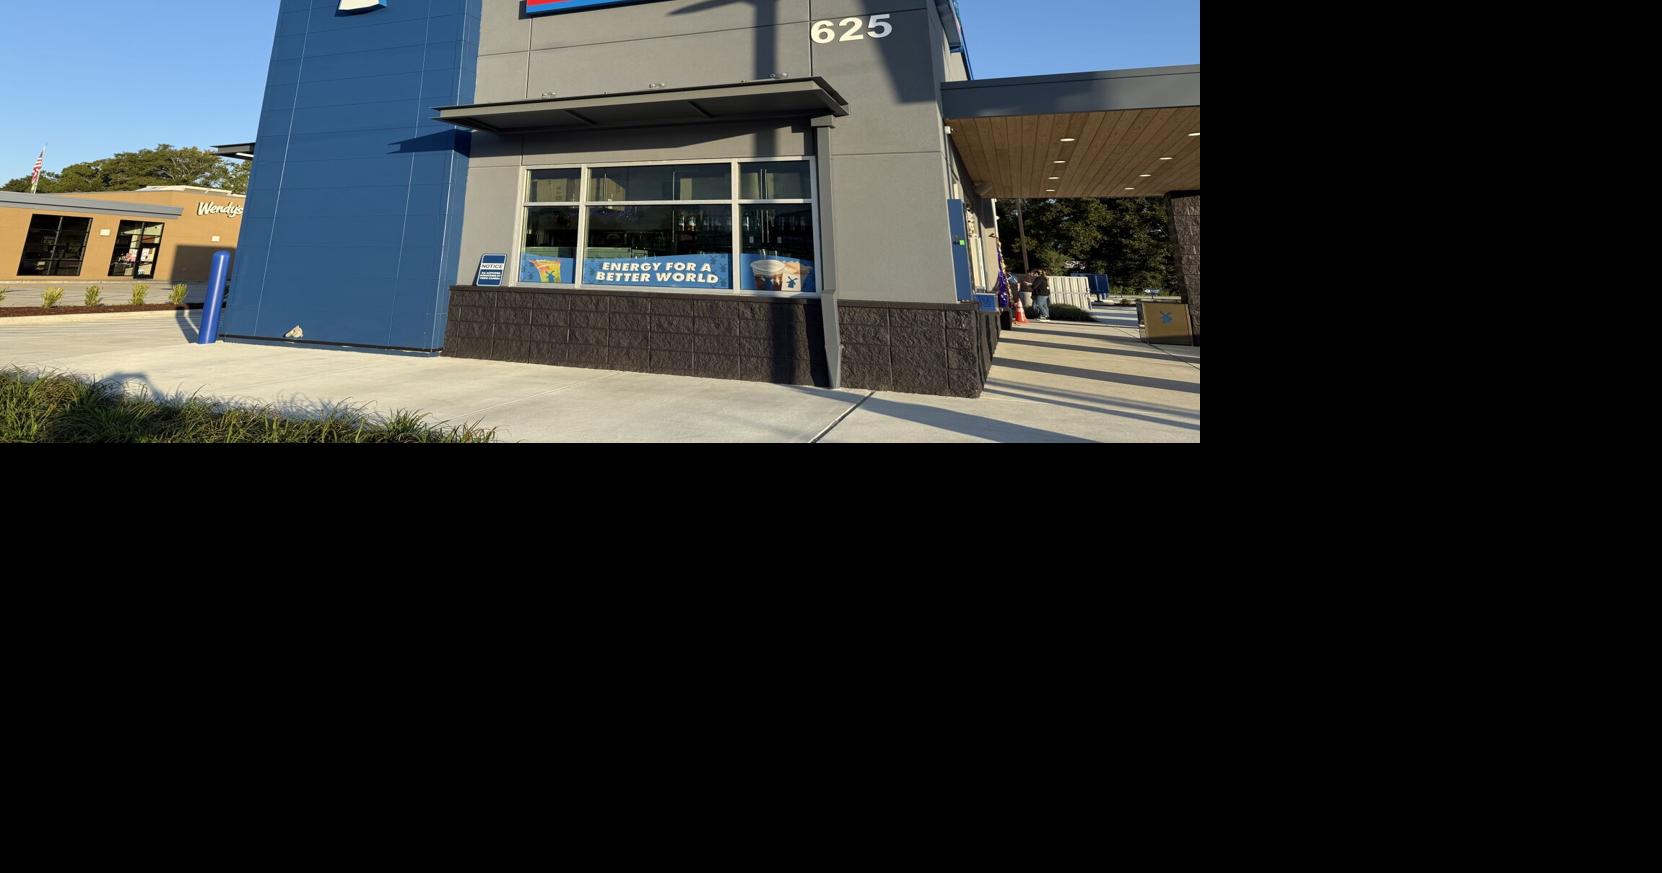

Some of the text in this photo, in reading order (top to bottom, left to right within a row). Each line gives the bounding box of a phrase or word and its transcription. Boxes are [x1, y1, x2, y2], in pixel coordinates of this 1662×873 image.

[811, 13, 892, 44] 625
[197, 201, 244, 218] Wendy's
[602, 261, 712, 272] ENERGY FOR A
[596, 271, 719, 284] BETTER WORLD
